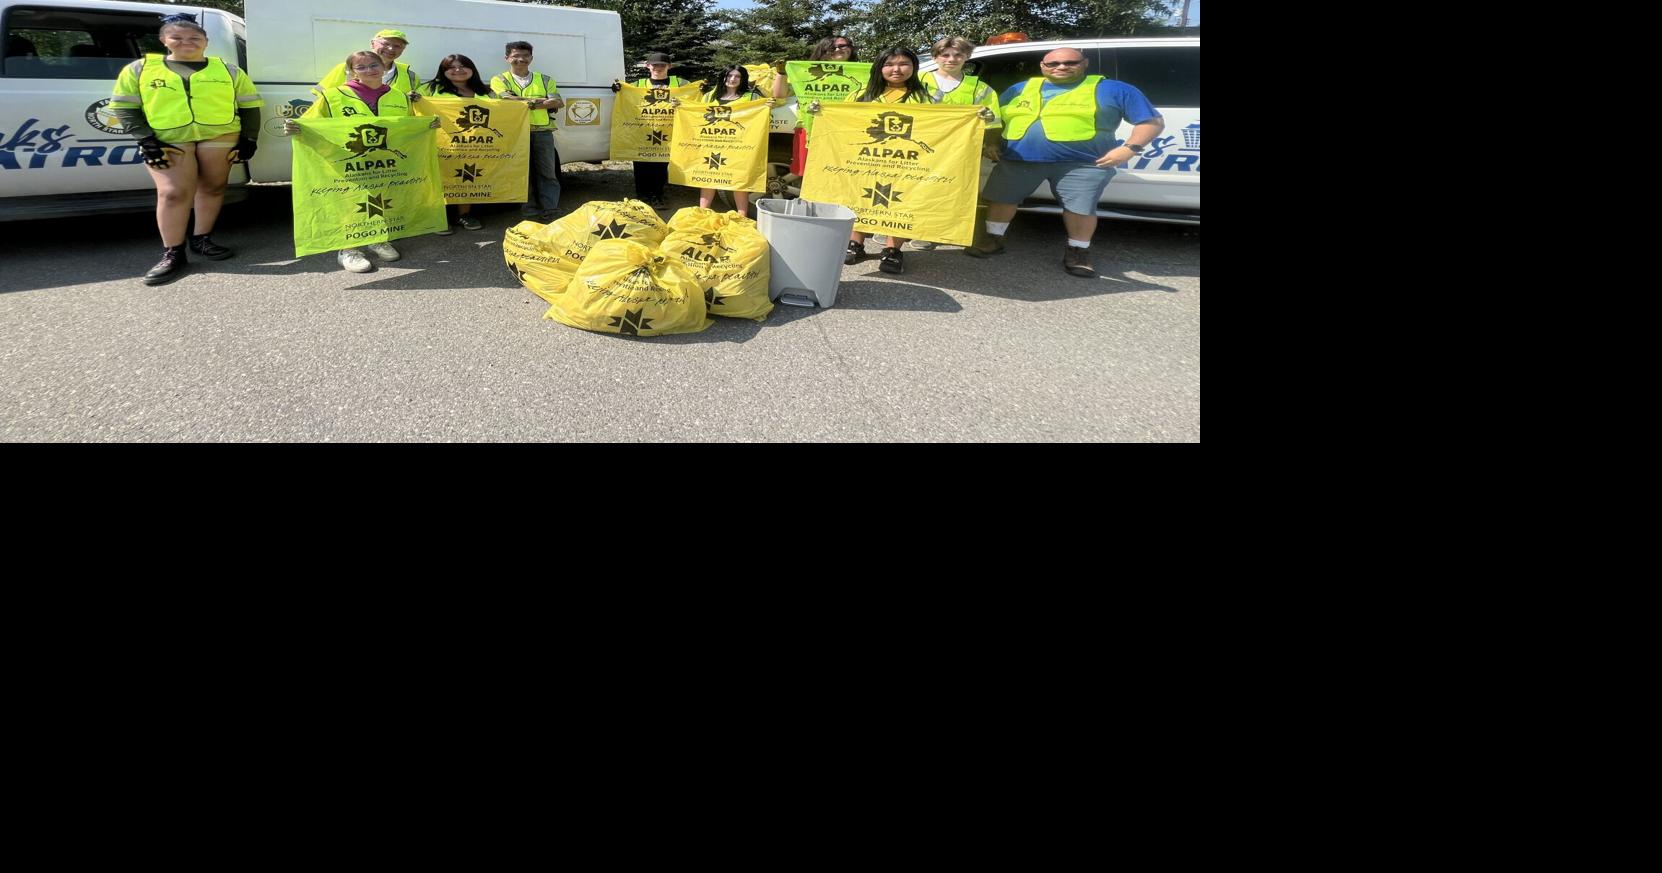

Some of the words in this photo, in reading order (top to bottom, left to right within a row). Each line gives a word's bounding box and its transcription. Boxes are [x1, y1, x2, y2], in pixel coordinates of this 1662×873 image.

[804, 84, 850, 92] ALPAR
[700, 127, 737, 136] ALPAR
[858, 147, 920, 161] ALPAR
[344, 158, 397, 173] ALPAR
[845, 159, 881, 168] Prevention
[857, 156, 887, 165] Alaskans
[894, 211, 915, 219] STAR
[854, 216, 878, 226] OGO
[881, 220, 913, 231] MINE
[346, 229, 378, 240] POGO
[380, 224, 406, 235] MINE
[572, 240, 593, 252] NORT
[565, 249, 586, 262] POG
